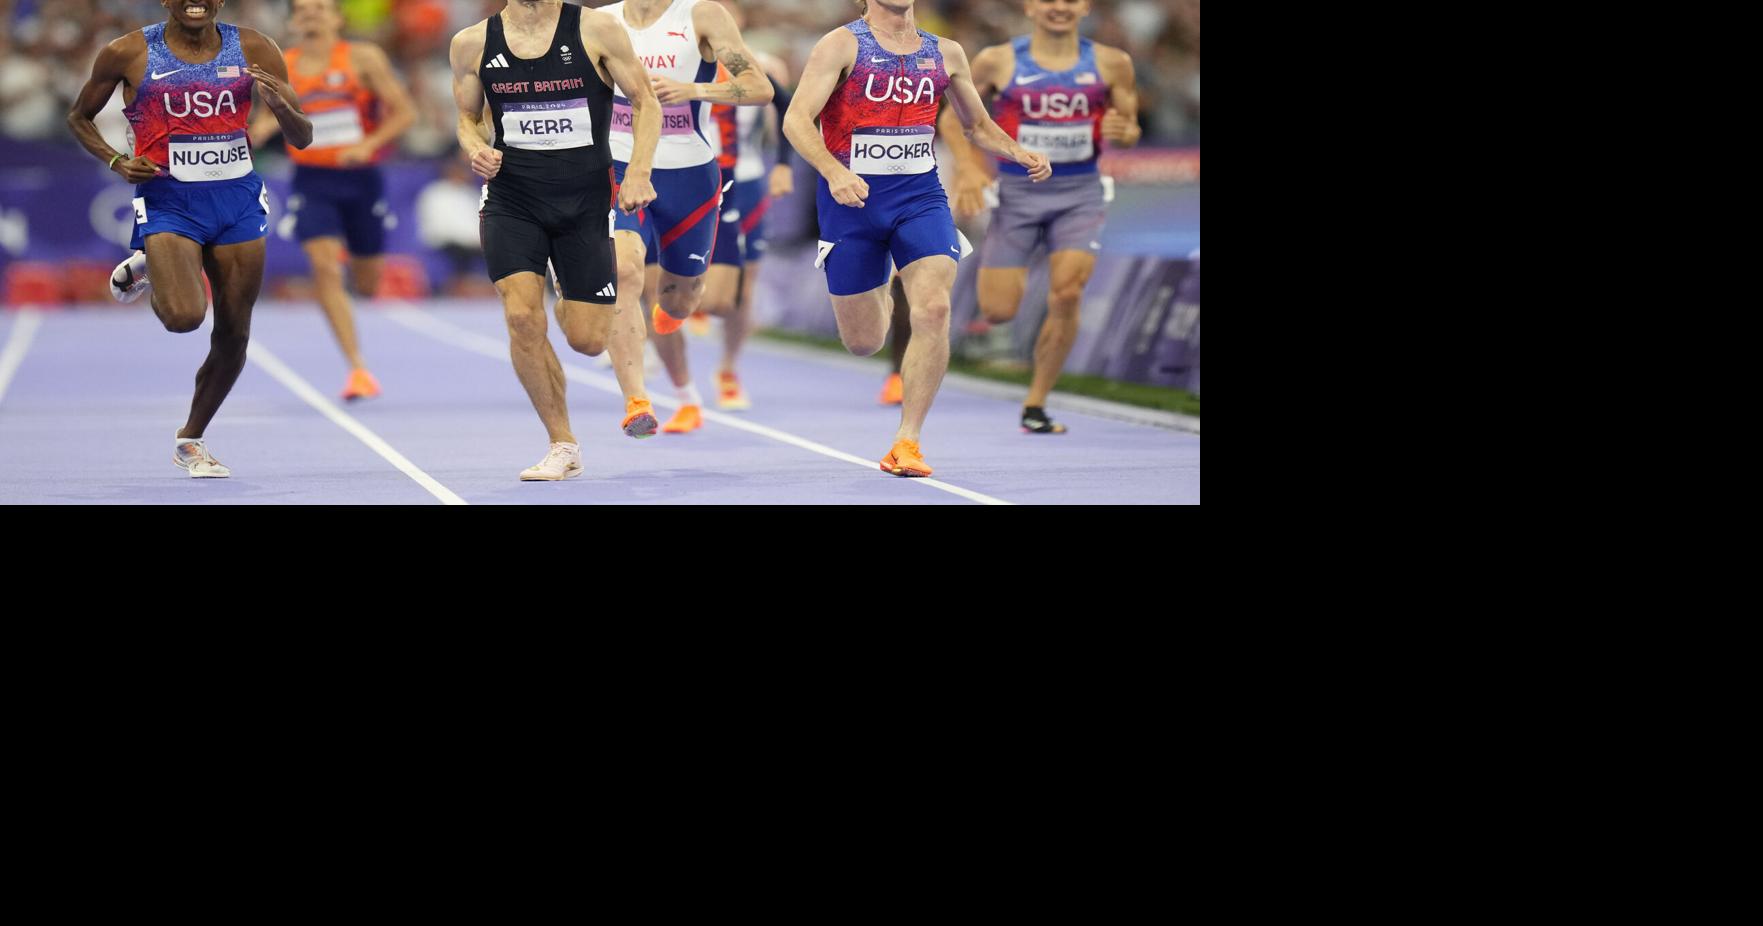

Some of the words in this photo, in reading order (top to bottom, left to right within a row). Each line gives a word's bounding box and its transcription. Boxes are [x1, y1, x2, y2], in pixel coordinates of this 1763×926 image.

[640, 55, 676, 69] WAY
[491, 81, 530, 94] GREAT
[534, 77, 584, 92] BRITAIN
[865, 73, 935, 105] USA
[163, 90, 237, 118] USA
[1022, 92, 1089, 119] USA
[519, 118, 573, 135] KERR
[173, 145, 248, 165] NUGUSE
[854, 142, 931, 160] HOCKER
